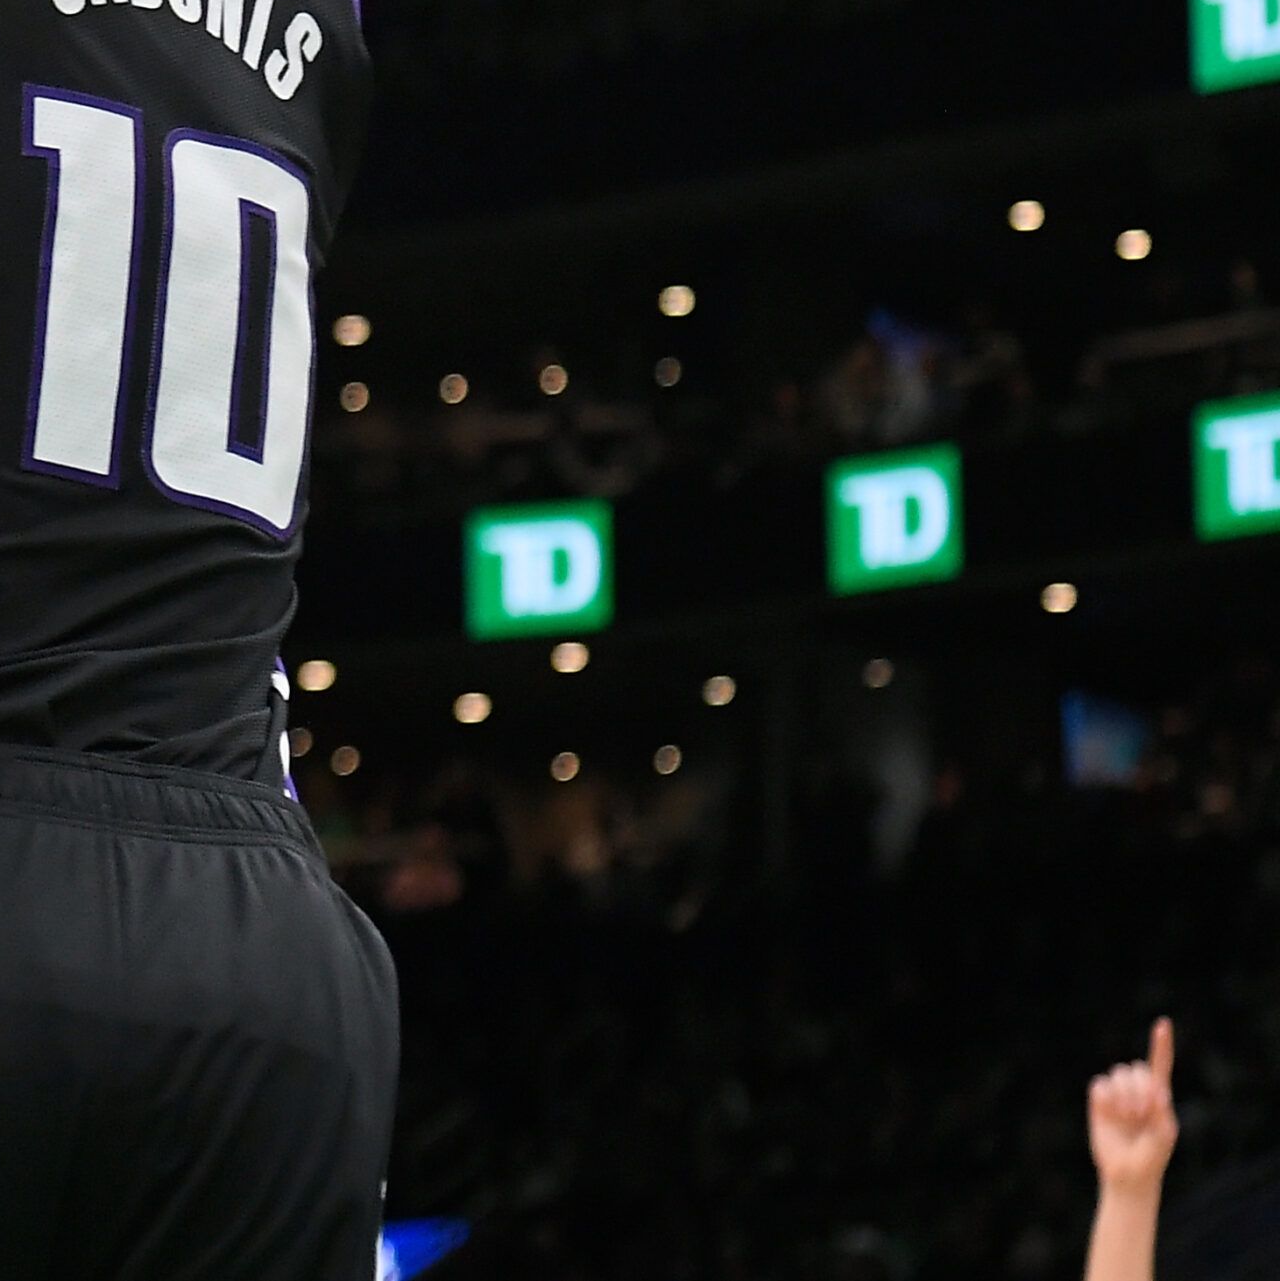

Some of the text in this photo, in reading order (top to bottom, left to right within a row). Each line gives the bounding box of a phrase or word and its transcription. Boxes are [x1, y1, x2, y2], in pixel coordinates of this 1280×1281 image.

[21, 82, 316, 541] 10
[480, 518, 603, 619] TD
[840, 464, 951, 572] TD
